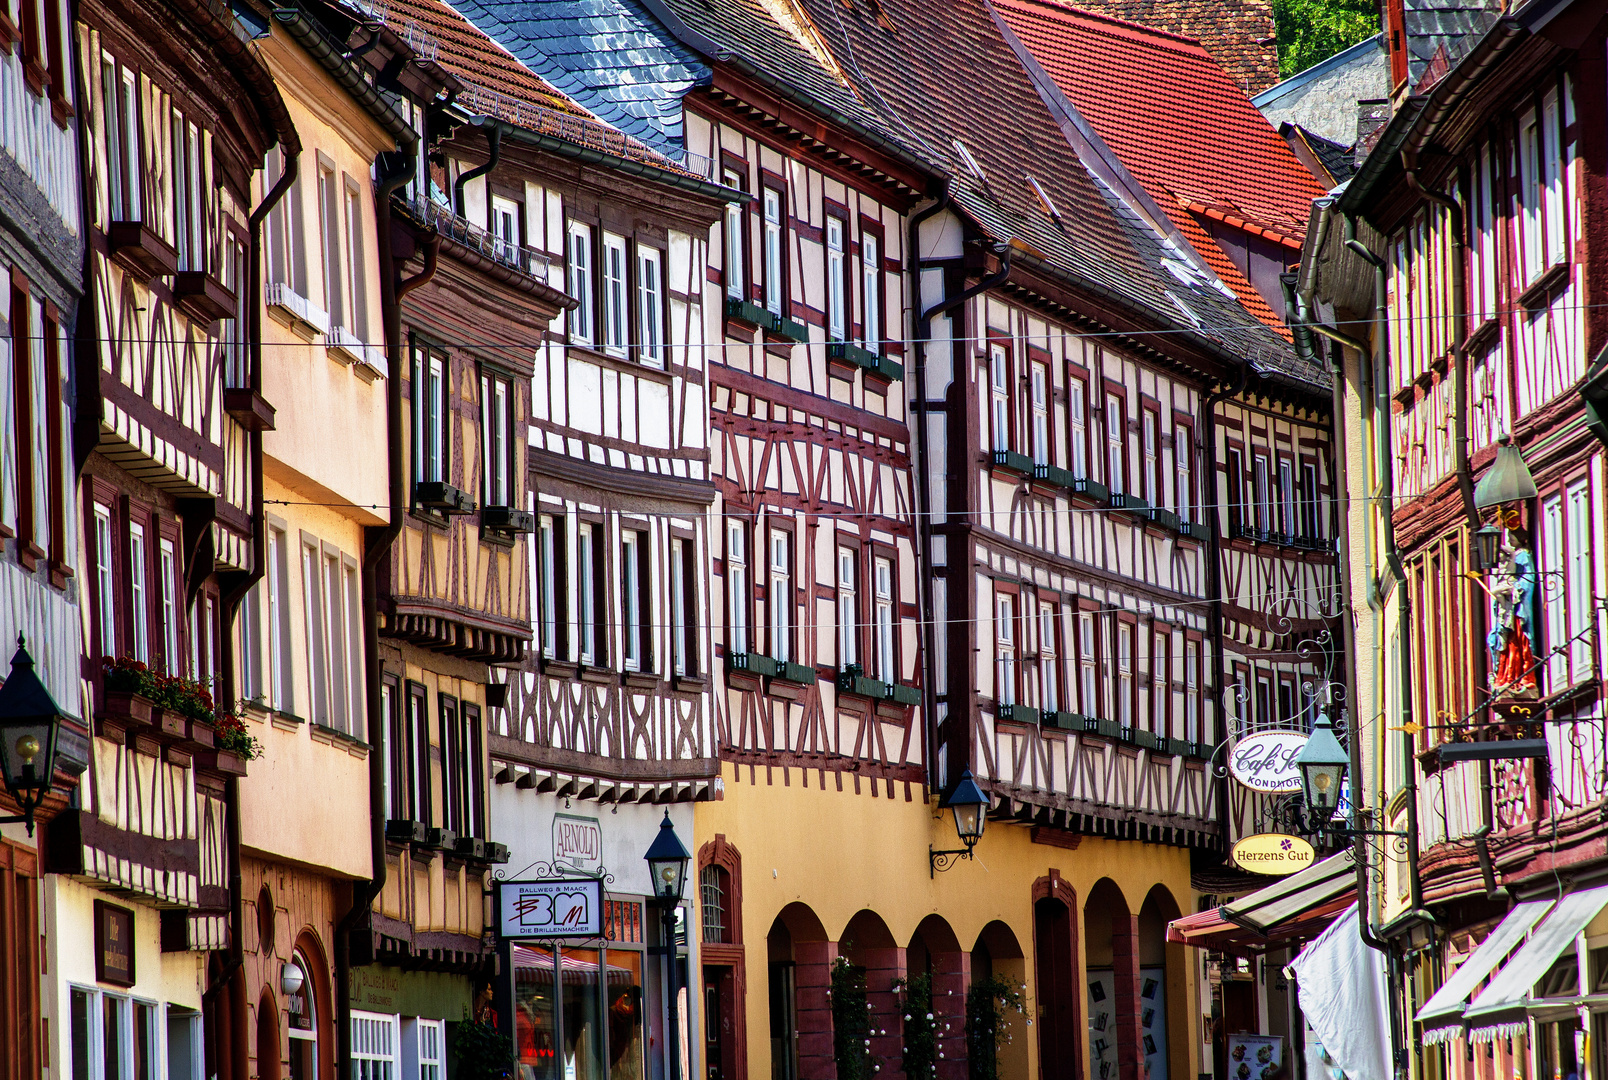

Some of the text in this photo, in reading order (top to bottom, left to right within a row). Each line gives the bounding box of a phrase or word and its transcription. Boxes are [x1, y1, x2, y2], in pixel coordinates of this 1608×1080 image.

[1235, 743, 1282, 776] Café
[556, 822, 599, 861] ARNOLD
[1237, 850, 1309, 861] Herzens Gut
